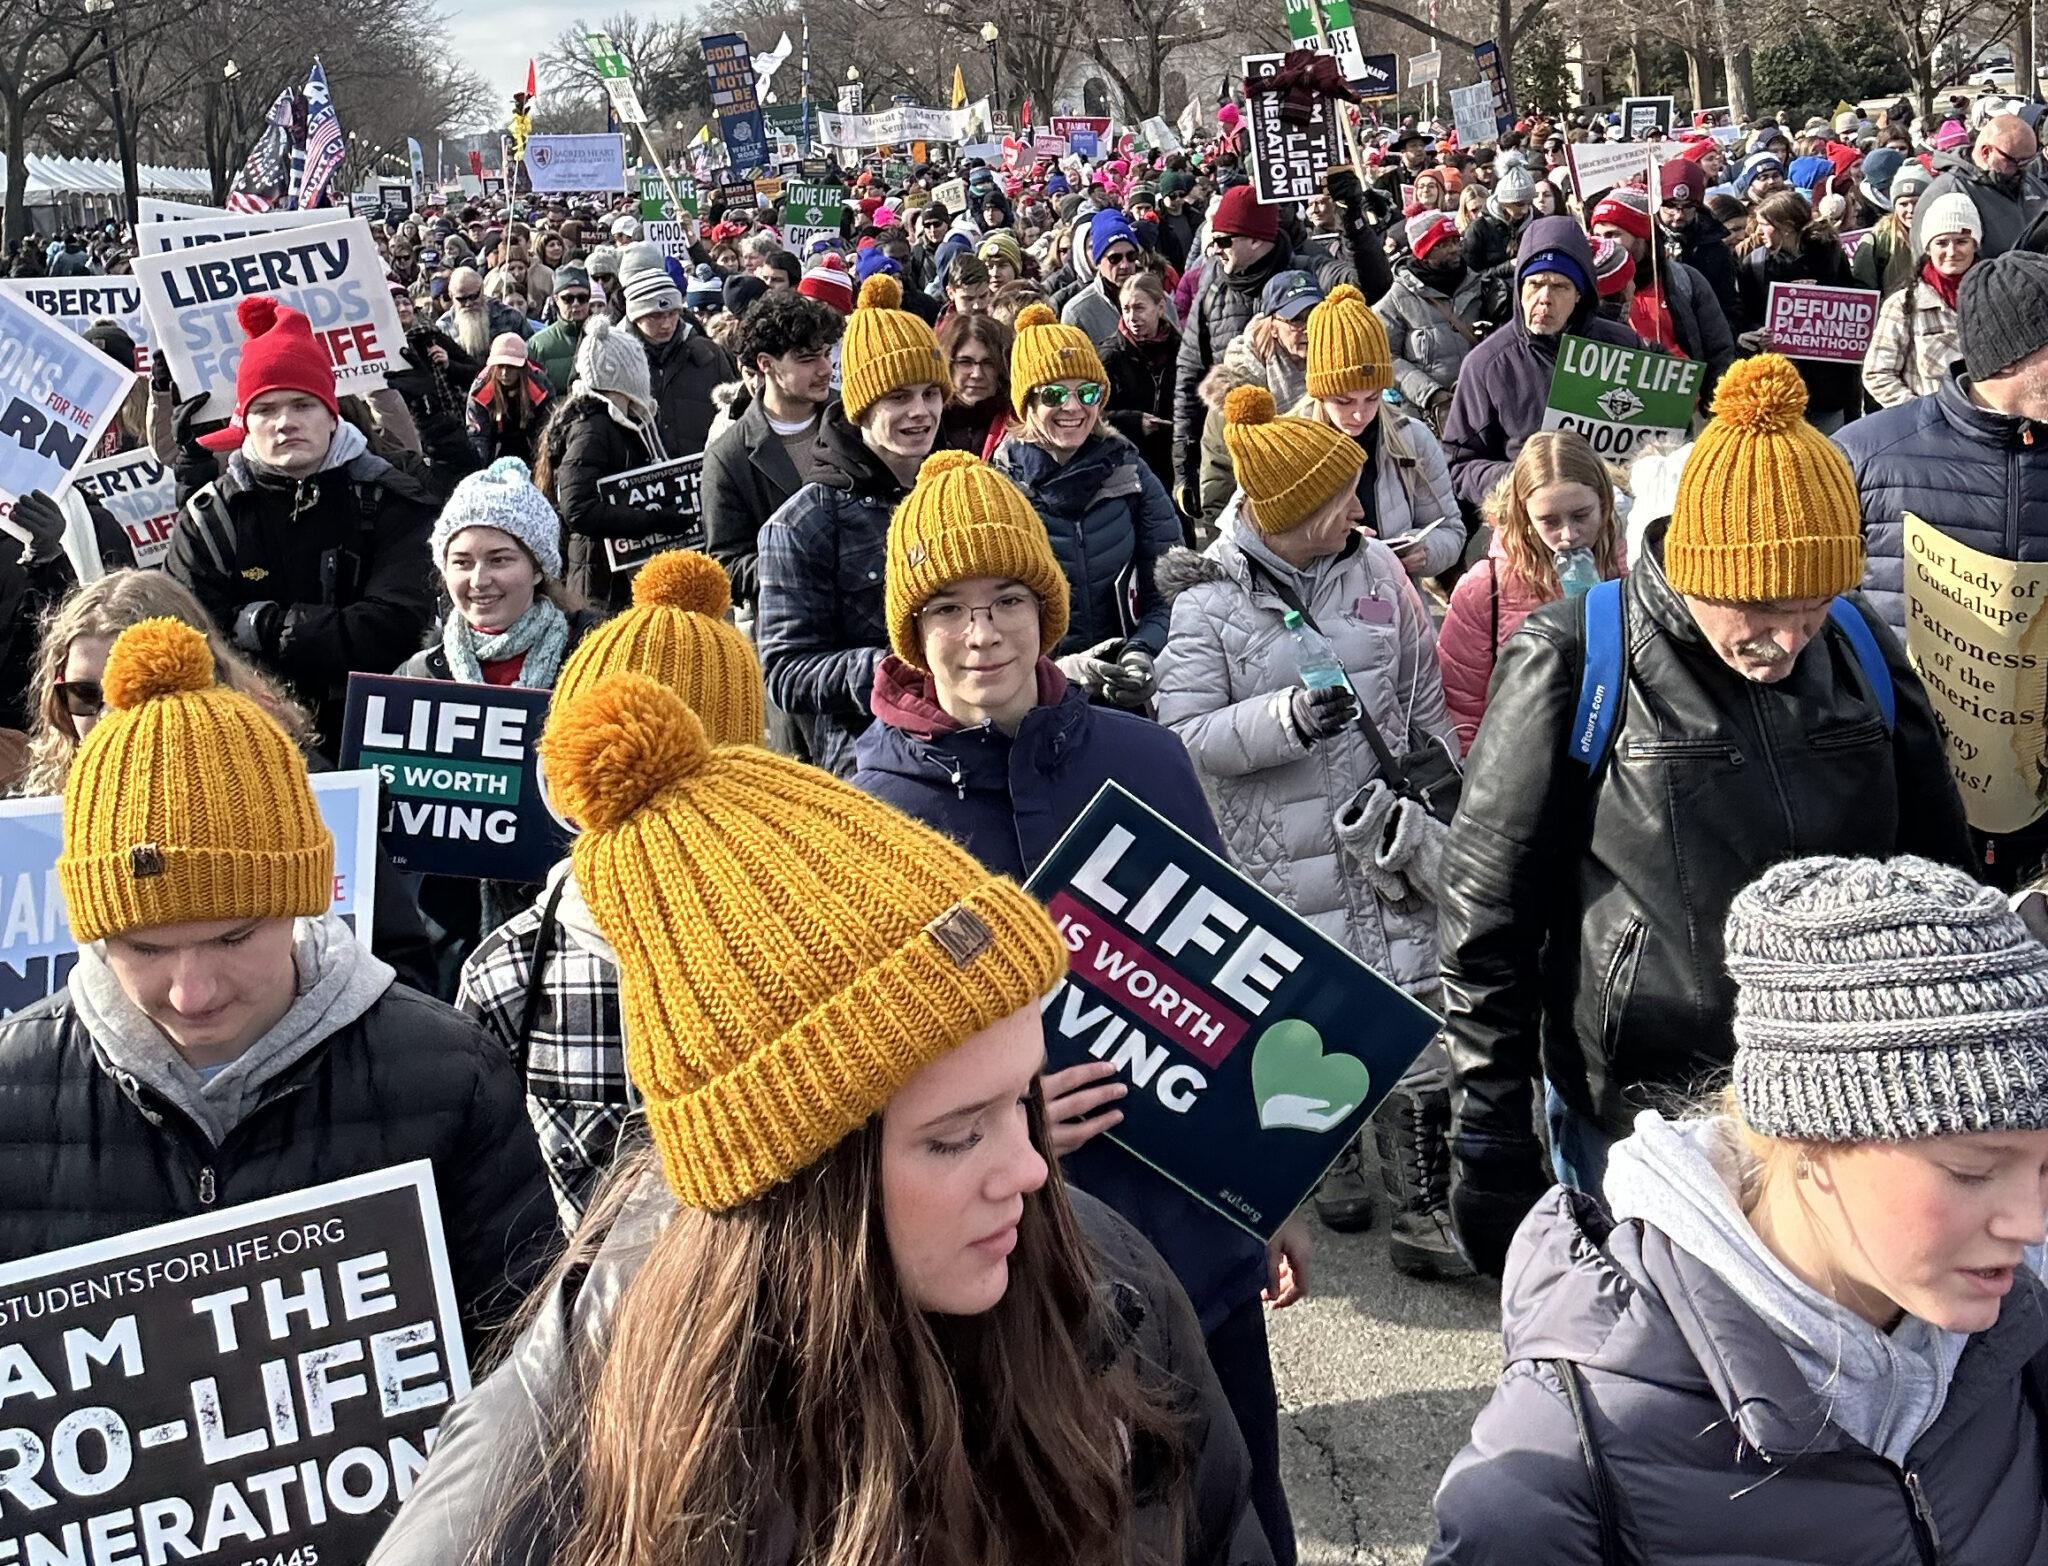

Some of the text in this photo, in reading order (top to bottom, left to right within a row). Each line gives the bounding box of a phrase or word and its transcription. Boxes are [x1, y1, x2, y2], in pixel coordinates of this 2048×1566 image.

[706, 45, 733, 61] GOD
[1303, 31, 1352, 56] CHOSE
[715, 59, 749, 75] WILL
[716, 73, 743, 90] NOT
[718, 101, 757, 117] MOCKED
[734, 89, 752, 101] BE
[861, 112, 896, 127] Mount
[914, 110, 951, 122] Mary's
[881, 122, 930, 135] Seminary
[1259, 63, 1289, 195] GNERATION
[553, 148, 615, 158] SACRED HEART
[1286, 123, 1313, 196] -LIFE
[789, 185, 819, 207] LOVE
[819, 187, 842, 208] LIFE
[650, 223, 685, 242] CHOO
[161, 238, 350, 309] LIBERTY
[26, 287, 141, 317] BERTY
[178, 280, 370, 350] STNDS
[1776, 296, 1873, 323] DEFUND
[313, 323, 386, 368] IFE
[1773, 332, 1868, 352] PARENTHOOD
[1774, 316, 1871, 340] PLANNED
[333, 361, 390, 380] RTY.EDU
[1563, 339, 1699, 394] LOVE LIFE
[47, 391, 71, 417] FOR
[69, 405, 94, 430] THE
[72, 459, 164, 499] ERTY
[628, 481, 666, 506] AM
[674, 470, 703, 492] TH
[126, 511, 178, 549] LIF
[1911, 534, 2040, 599] Our Lady of
[1917, 563, 2028, 627] Guadalupe
[1909, 594, 2038, 670] Patroness
[1912, 654, 2036, 726] Americas
[1934, 651, 1996, 694] of the
[363, 695, 528, 761] LIFE
[1934, 709, 1979, 761] Pray
[403, 766, 508, 796] WORTH
[1954, 766, 1992, 794] us!
[381, 800, 518, 844] VING
[1069, 823, 1304, 1017] LIFE
[1093, 940, 1226, 1048] WORTH
[1040, 976, 1208, 1114] IVING
[0, 1218, 346, 1327] STUDENTSFORLIFE.ORG
[0, 1250, 397, 1402] AM THE
